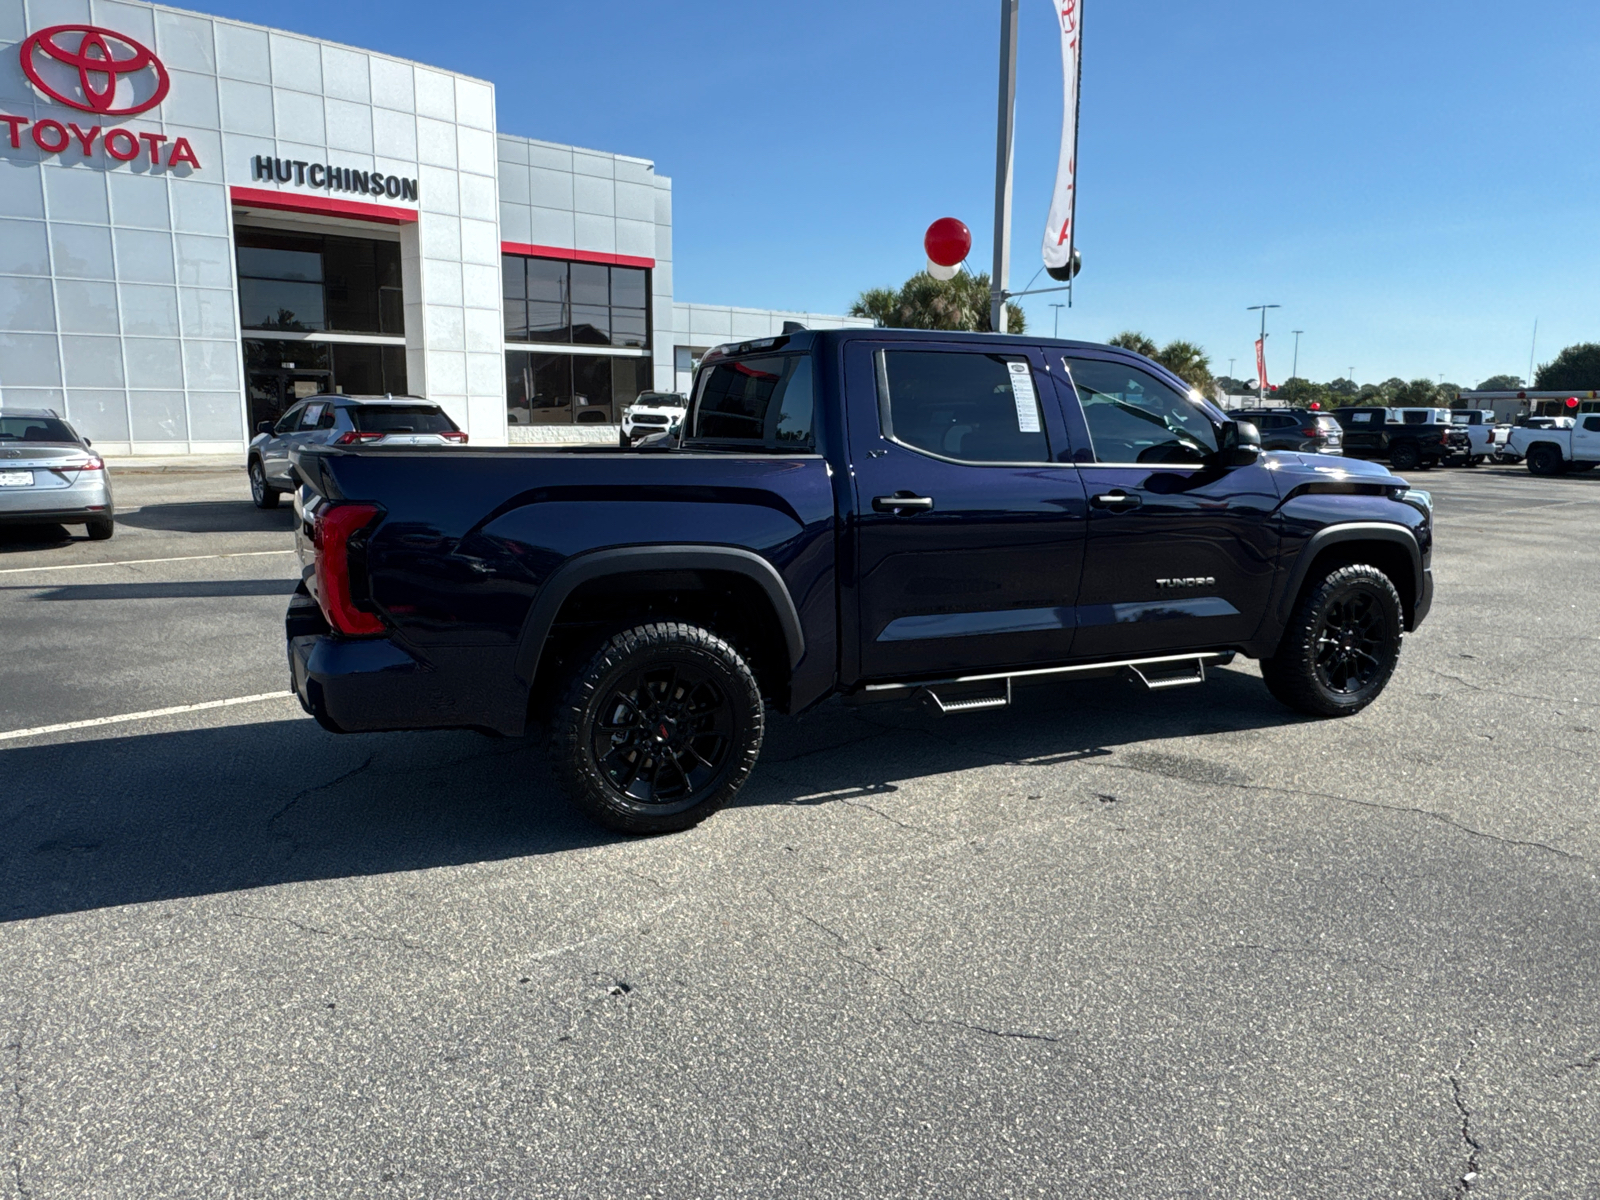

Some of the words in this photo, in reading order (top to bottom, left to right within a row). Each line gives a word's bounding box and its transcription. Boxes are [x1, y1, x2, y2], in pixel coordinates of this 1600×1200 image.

[0, 114, 201, 169] TOYOTA
[254, 154, 418, 201] HUTCHINSON
[1155, 576, 1215, 589] TUNDRA
